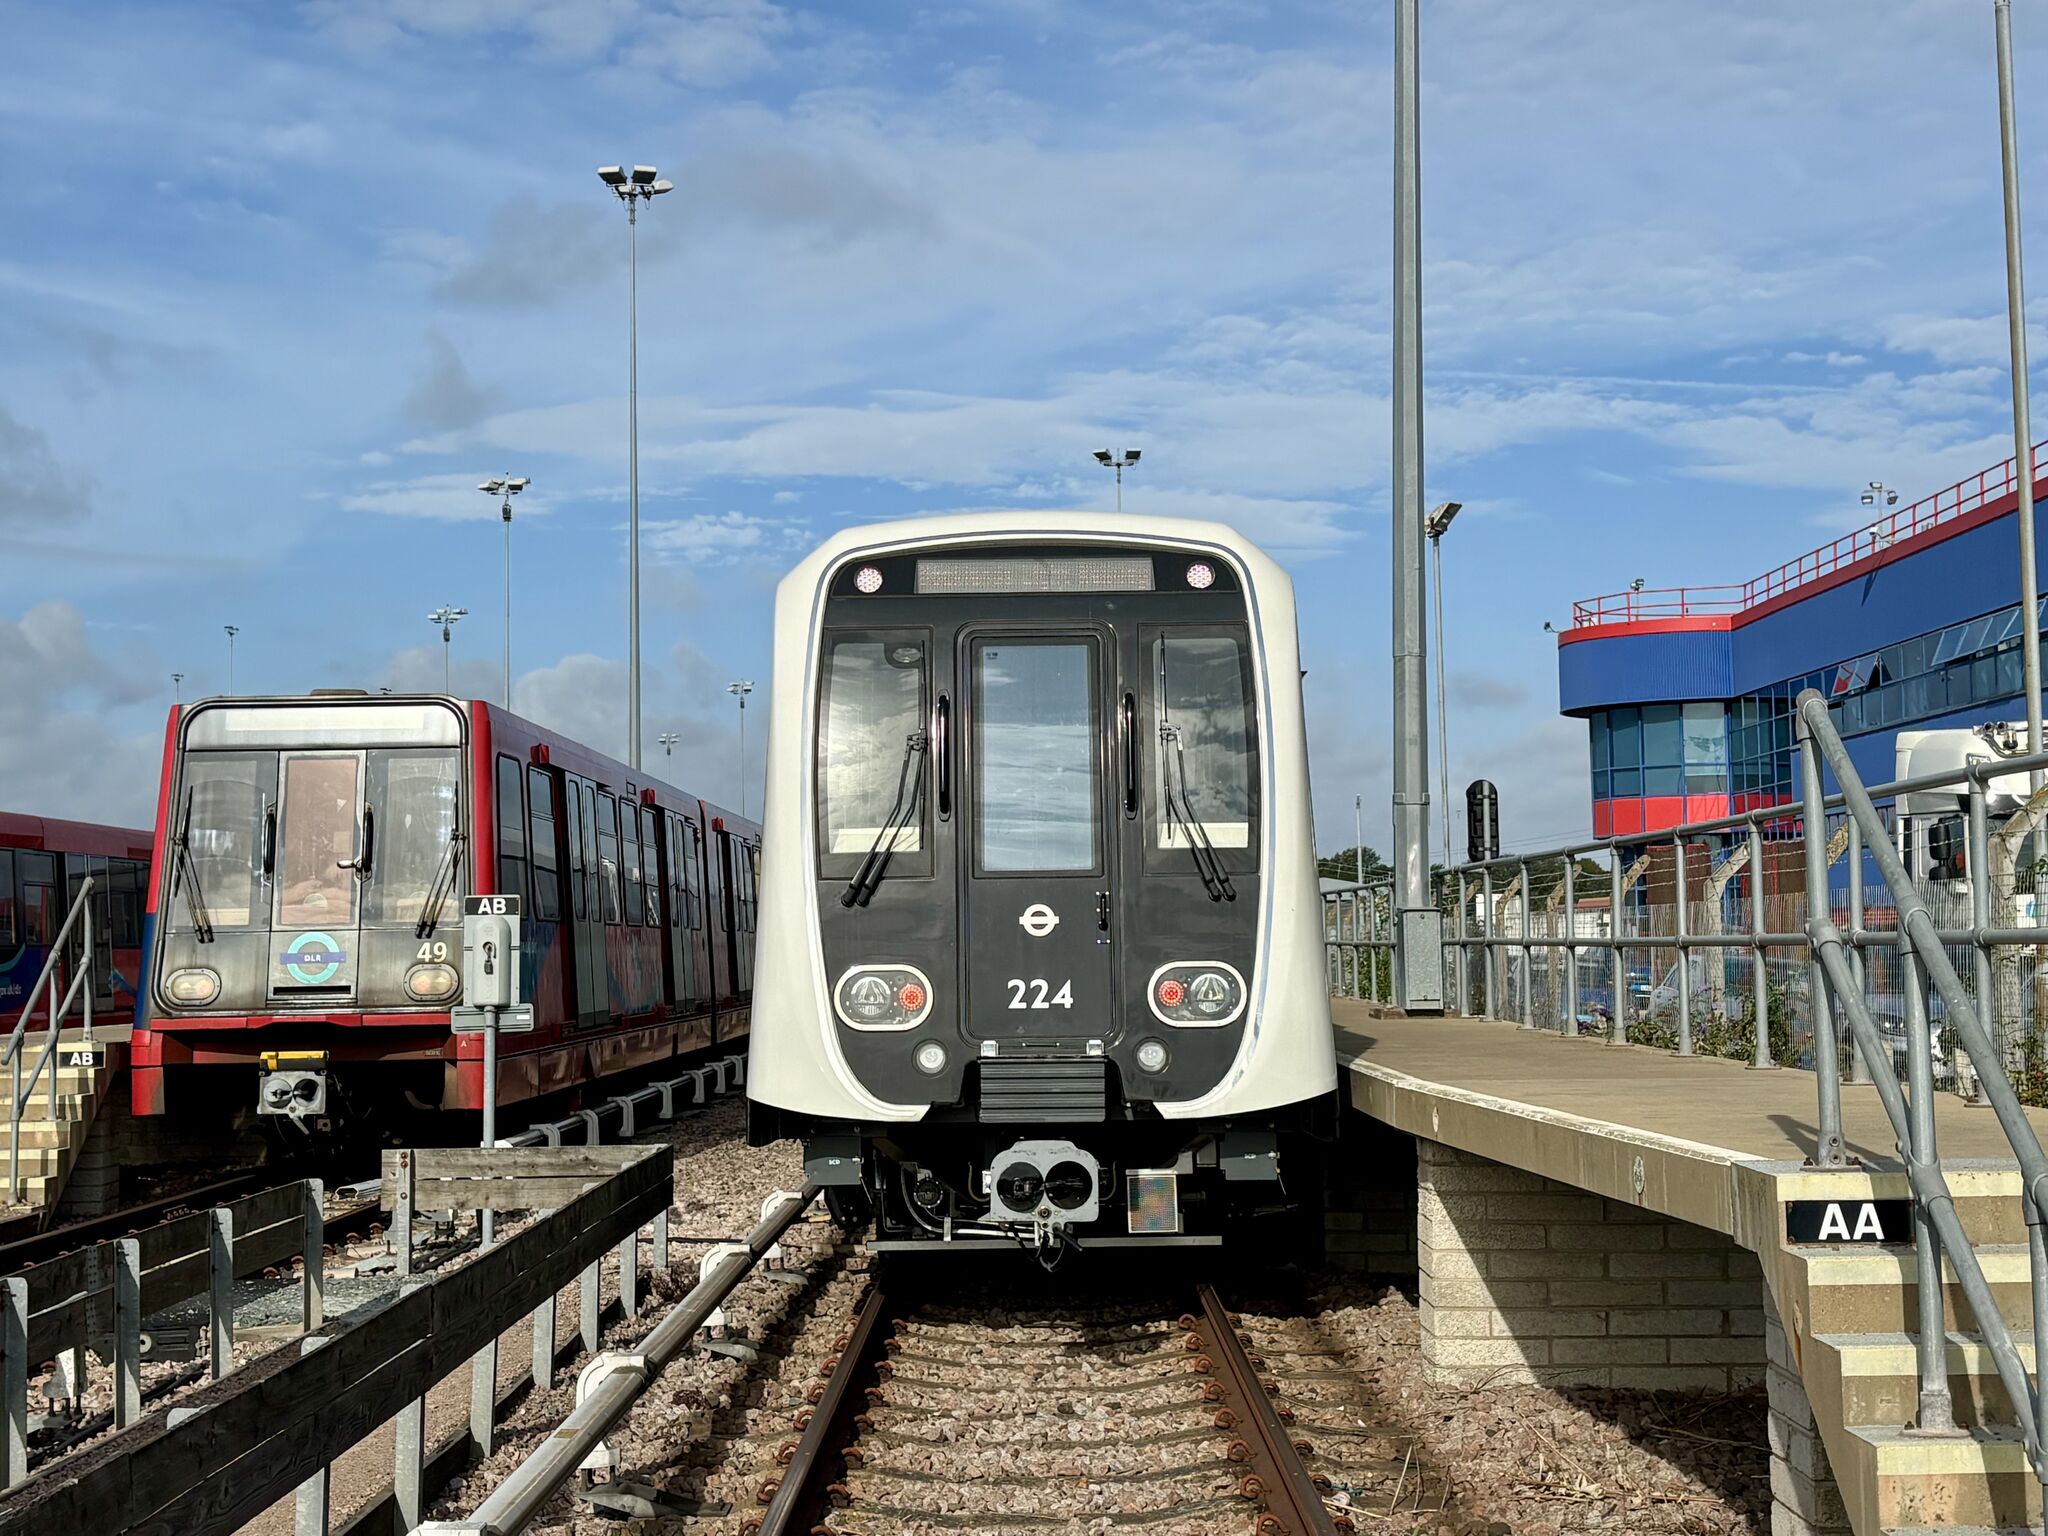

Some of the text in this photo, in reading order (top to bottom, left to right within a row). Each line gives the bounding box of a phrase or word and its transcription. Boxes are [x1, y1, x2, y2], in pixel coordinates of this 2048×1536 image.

[478, 898, 507, 915] AB
[304, 954, 322, 962] DLR
[416, 941, 447, 963] 49
[1007, 978, 1074, 1009] 224
[69, 1052, 94, 1066] AB
[1818, 1202, 1885, 1240] AA
